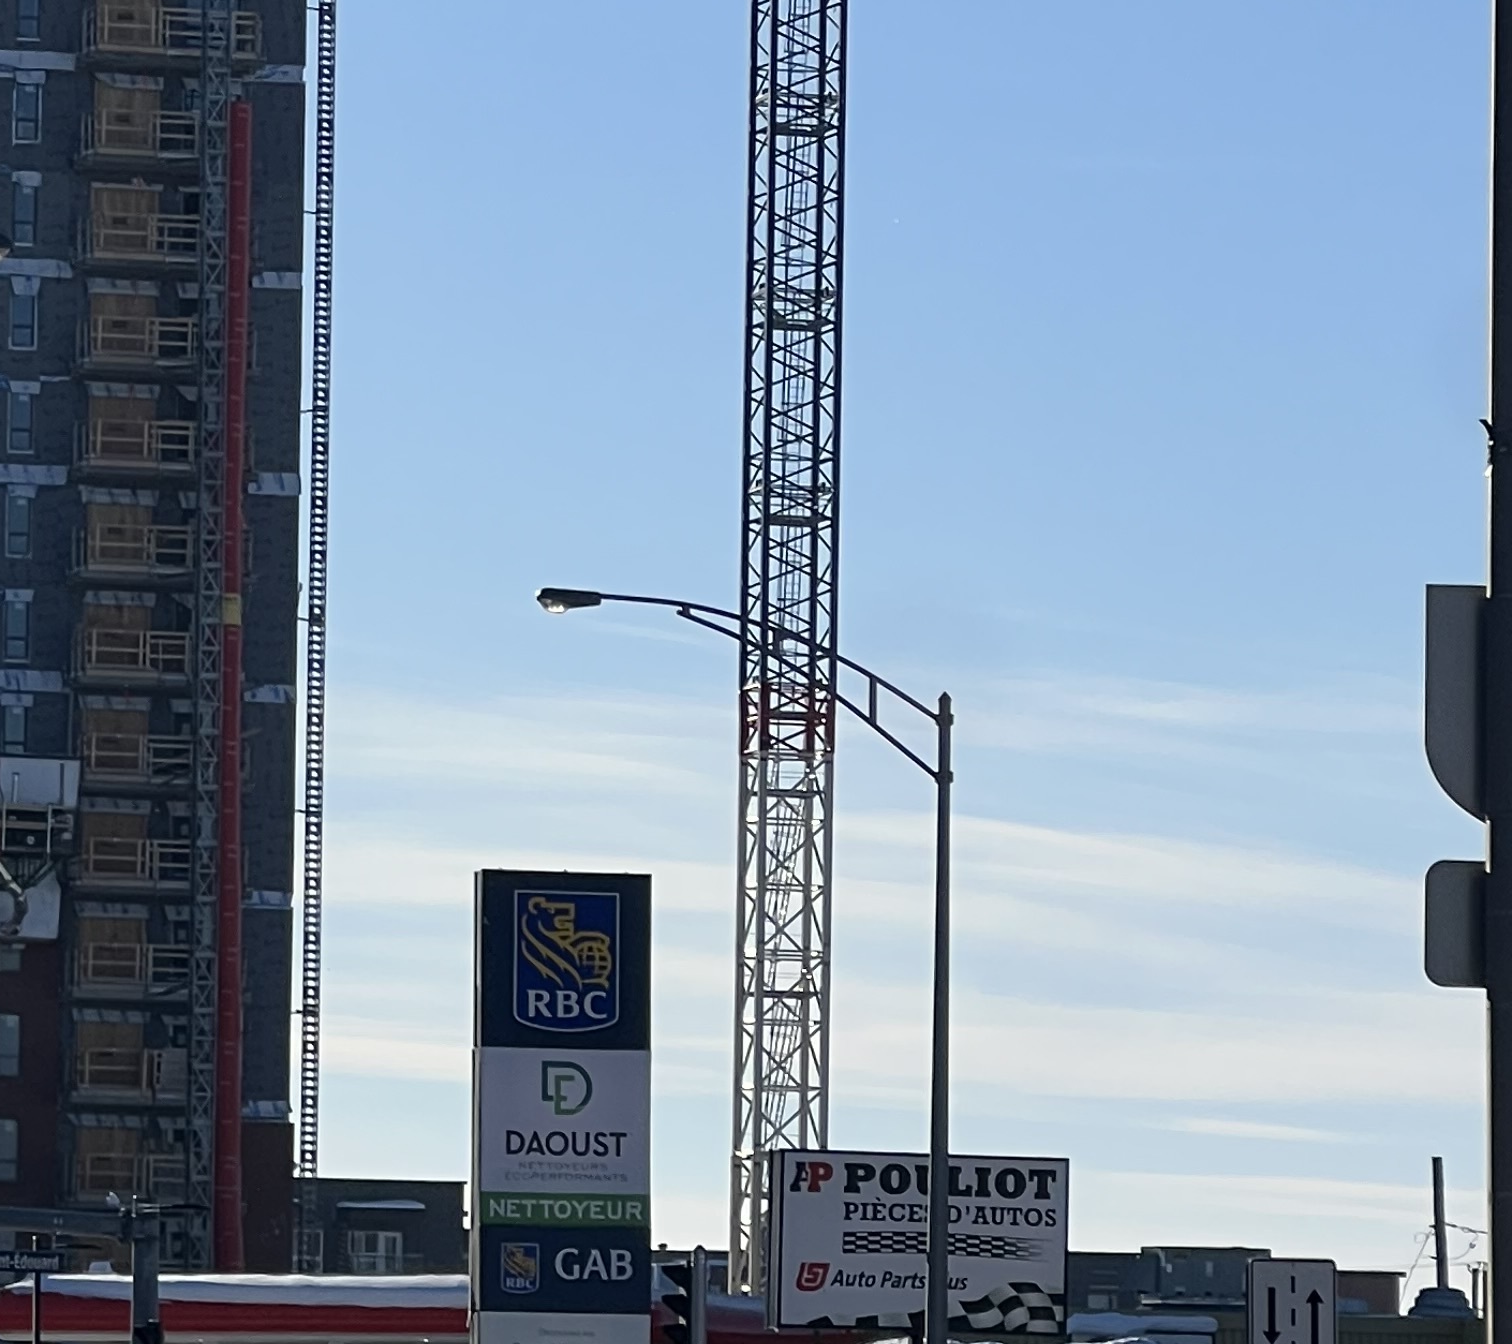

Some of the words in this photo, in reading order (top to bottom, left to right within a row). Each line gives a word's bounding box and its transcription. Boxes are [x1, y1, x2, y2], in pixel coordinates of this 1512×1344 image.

[526, 989, 608, 1019] RBC
[506, 1130, 628, 1157] DAOUST
[489, 1198, 643, 1220] NETTOYEUR
[948, 1205, 1057, 1227] D'AUTOS
[554, 1247, 634, 1281] GAB
[830, 1268, 876, 1288] Auto
[879, 1270, 926, 1290] Parts
